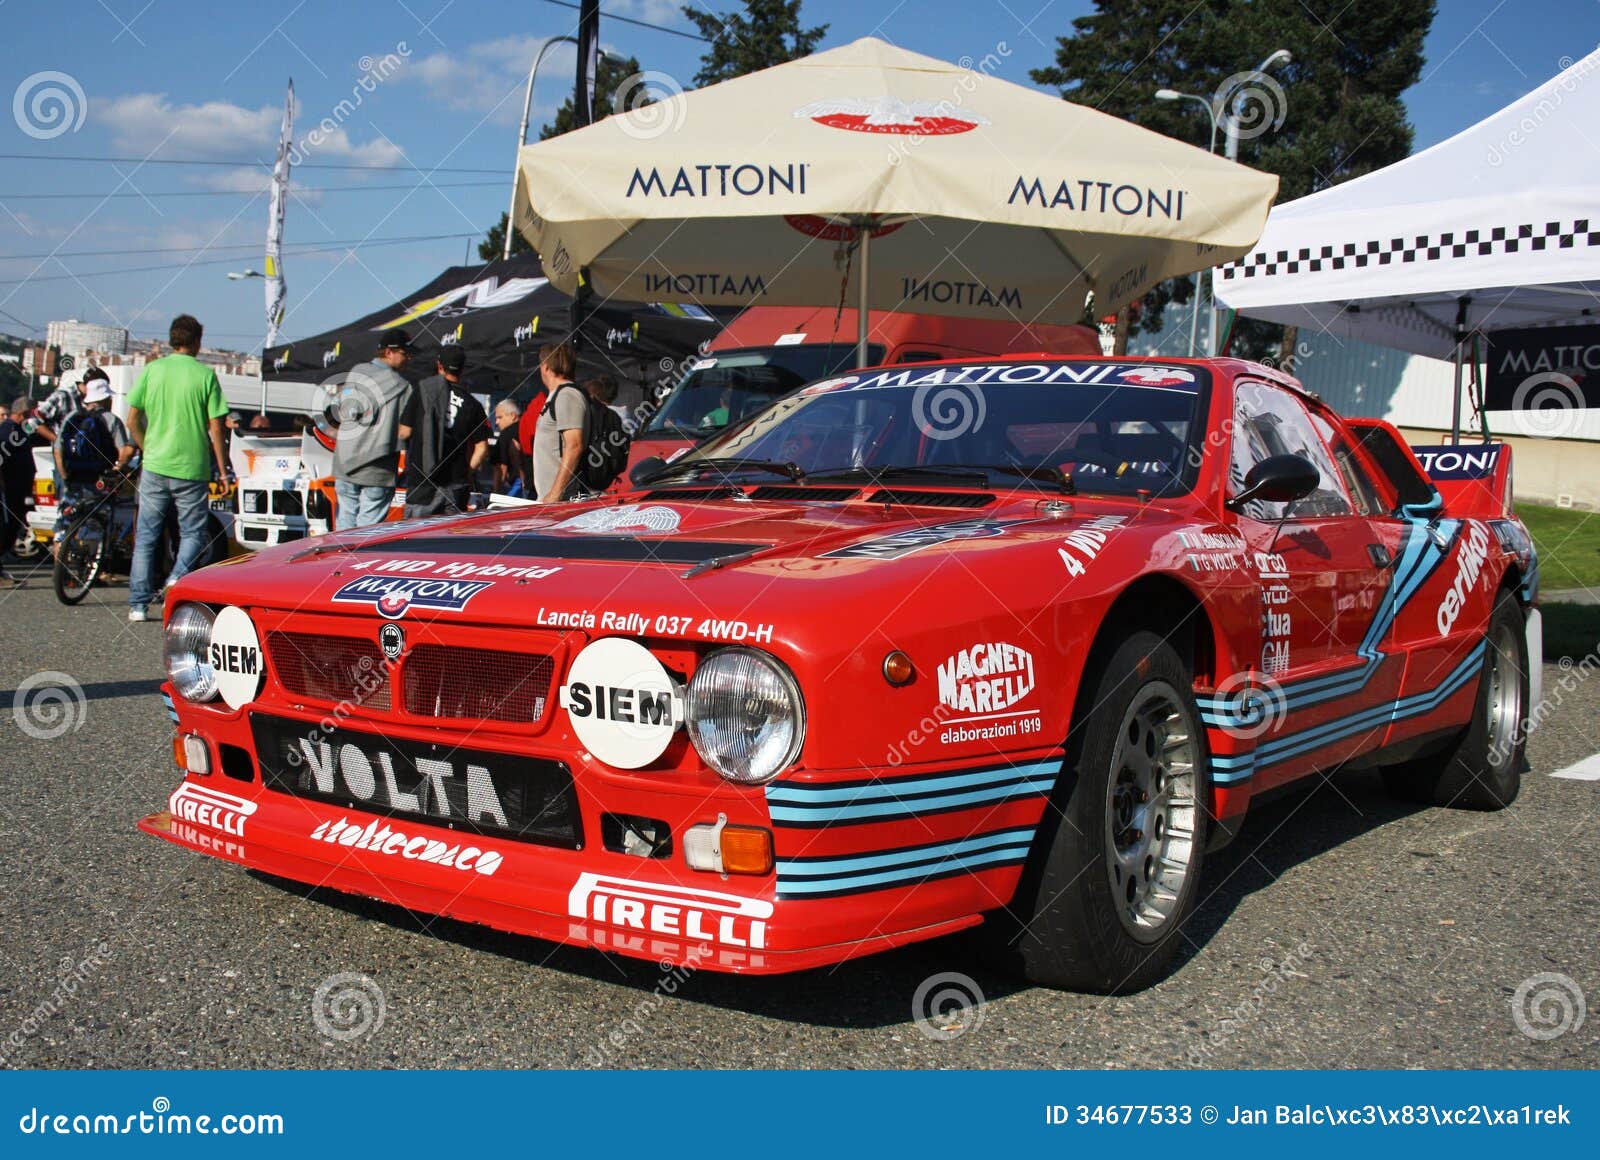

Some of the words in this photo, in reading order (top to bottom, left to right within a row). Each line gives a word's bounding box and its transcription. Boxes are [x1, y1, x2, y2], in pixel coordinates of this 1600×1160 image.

[626, 164, 805, 198] MATTONI
[1008, 176, 1184, 221] MATTONI
[851, 365, 1117, 389] MATTONI
[1064, 529, 1107, 560] WD
[1210, 552, 1239, 571] VOLTA
[351, 559, 376, 570] 4
[377, 559, 436, 575] WD
[434, 561, 562, 580] Hybrid
[1057, 548, 1087, 577] 4
[346, 577, 481, 599] MATTONI
[537, 607, 596, 629] Lancia
[601, 611, 651, 637] Rally
[655, 615, 693, 635] 037
[698, 618, 775, 644] 4WD-H
[212, 644, 257, 675] SIEM
[937, 643, 1034, 684] MAGNETI
[569, 683, 673, 726] SIEM
[937, 674, 1035, 712] MARELLI
[940, 723, 1017, 744] elaborazioni
[1019, 717, 1041, 735] 1919
[299, 738, 508, 827] VOLTA
[169, 781, 257, 837] PIRELLI
[568, 872, 774, 949] PIRELLI
